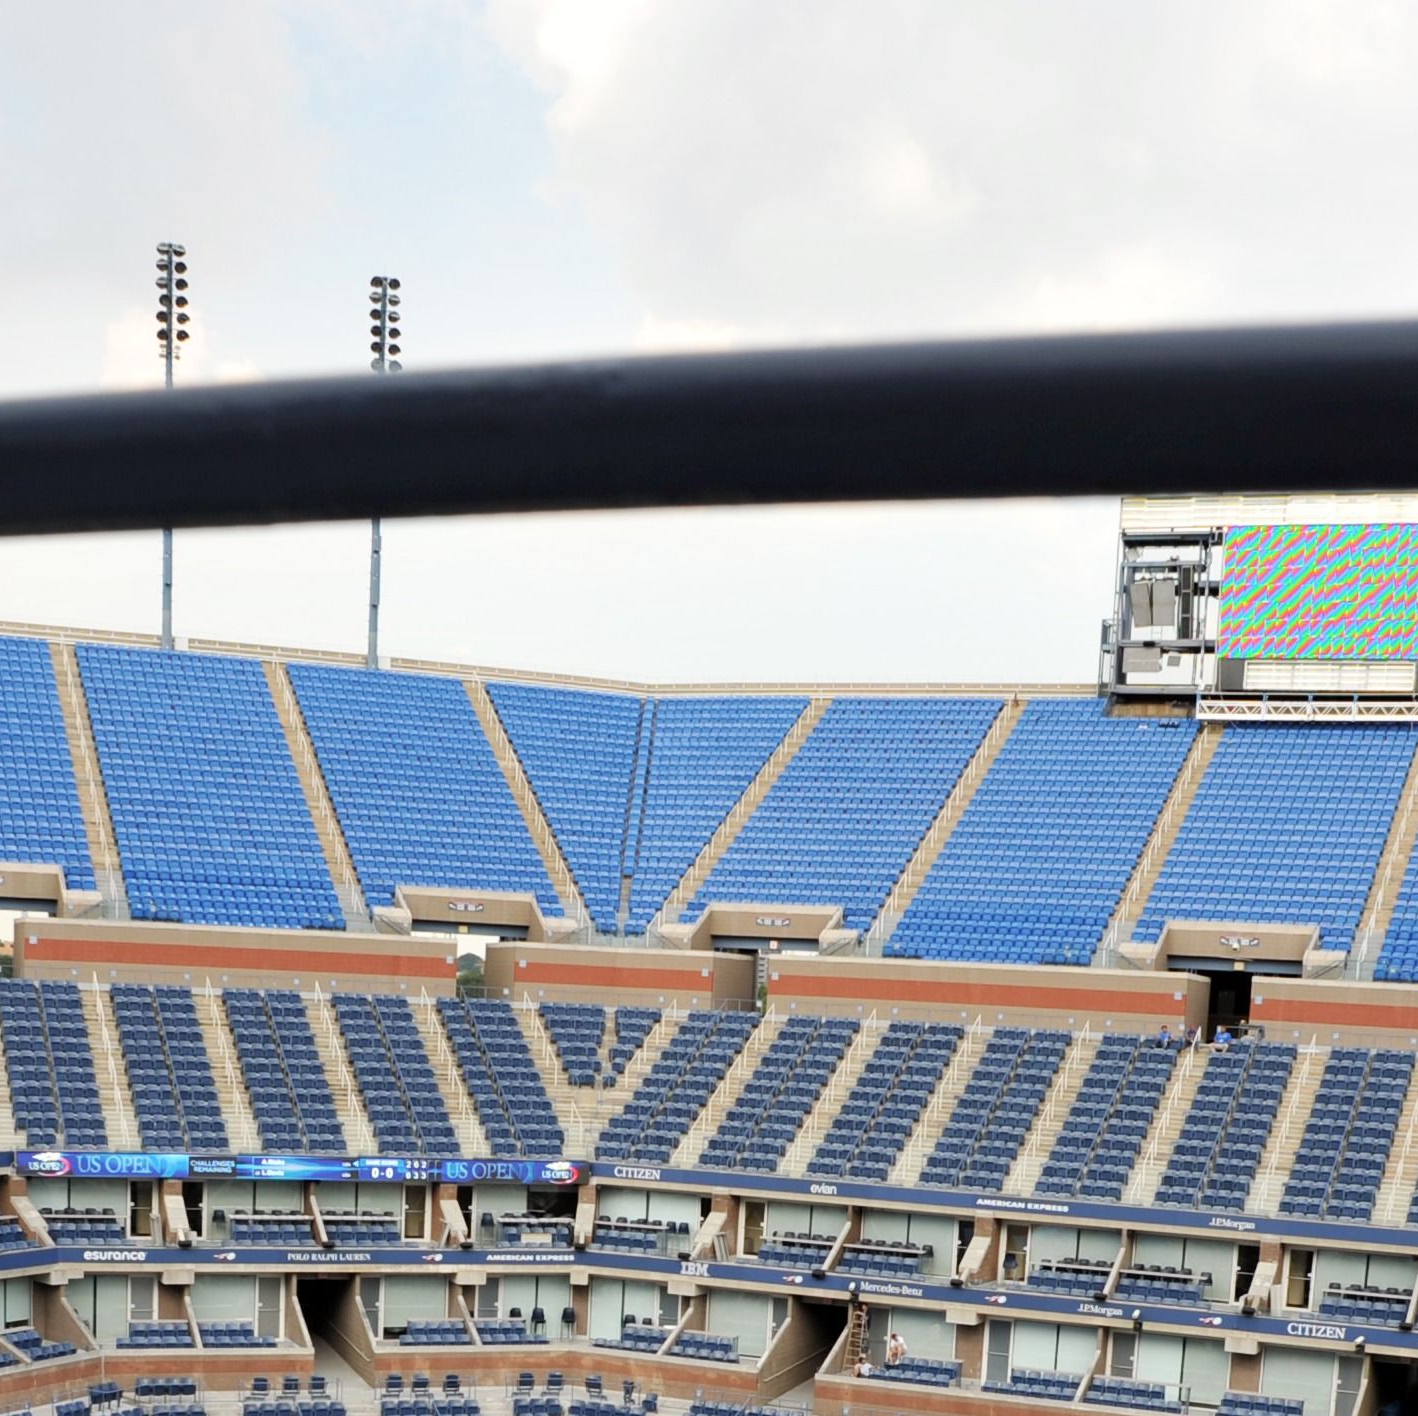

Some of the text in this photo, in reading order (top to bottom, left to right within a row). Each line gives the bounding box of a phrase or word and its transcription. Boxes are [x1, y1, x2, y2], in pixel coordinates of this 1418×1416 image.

[77, 1155, 161, 1174] US OPEN
[445, 1161, 523, 1181] US OPEN
[614, 1166, 661, 1181] CITIZEN
[810, 1182, 838, 1195] evian
[976, 1198, 1070, 1213] AMERICAN EXPRESS
[83, 1250, 147, 1261] esurance
[287, 1252, 371, 1262] POLO RALPH LAUREN
[485, 1253, 575, 1262] AMERICAN EXPRESS
[680, 1261, 710, 1277] IBM
[860, 1280, 923, 1297] Mercedes-Benz
[1076, 1302, 1123, 1317] J.P.Morgan
[1287, 1322, 1347, 1340] CITIZEN
